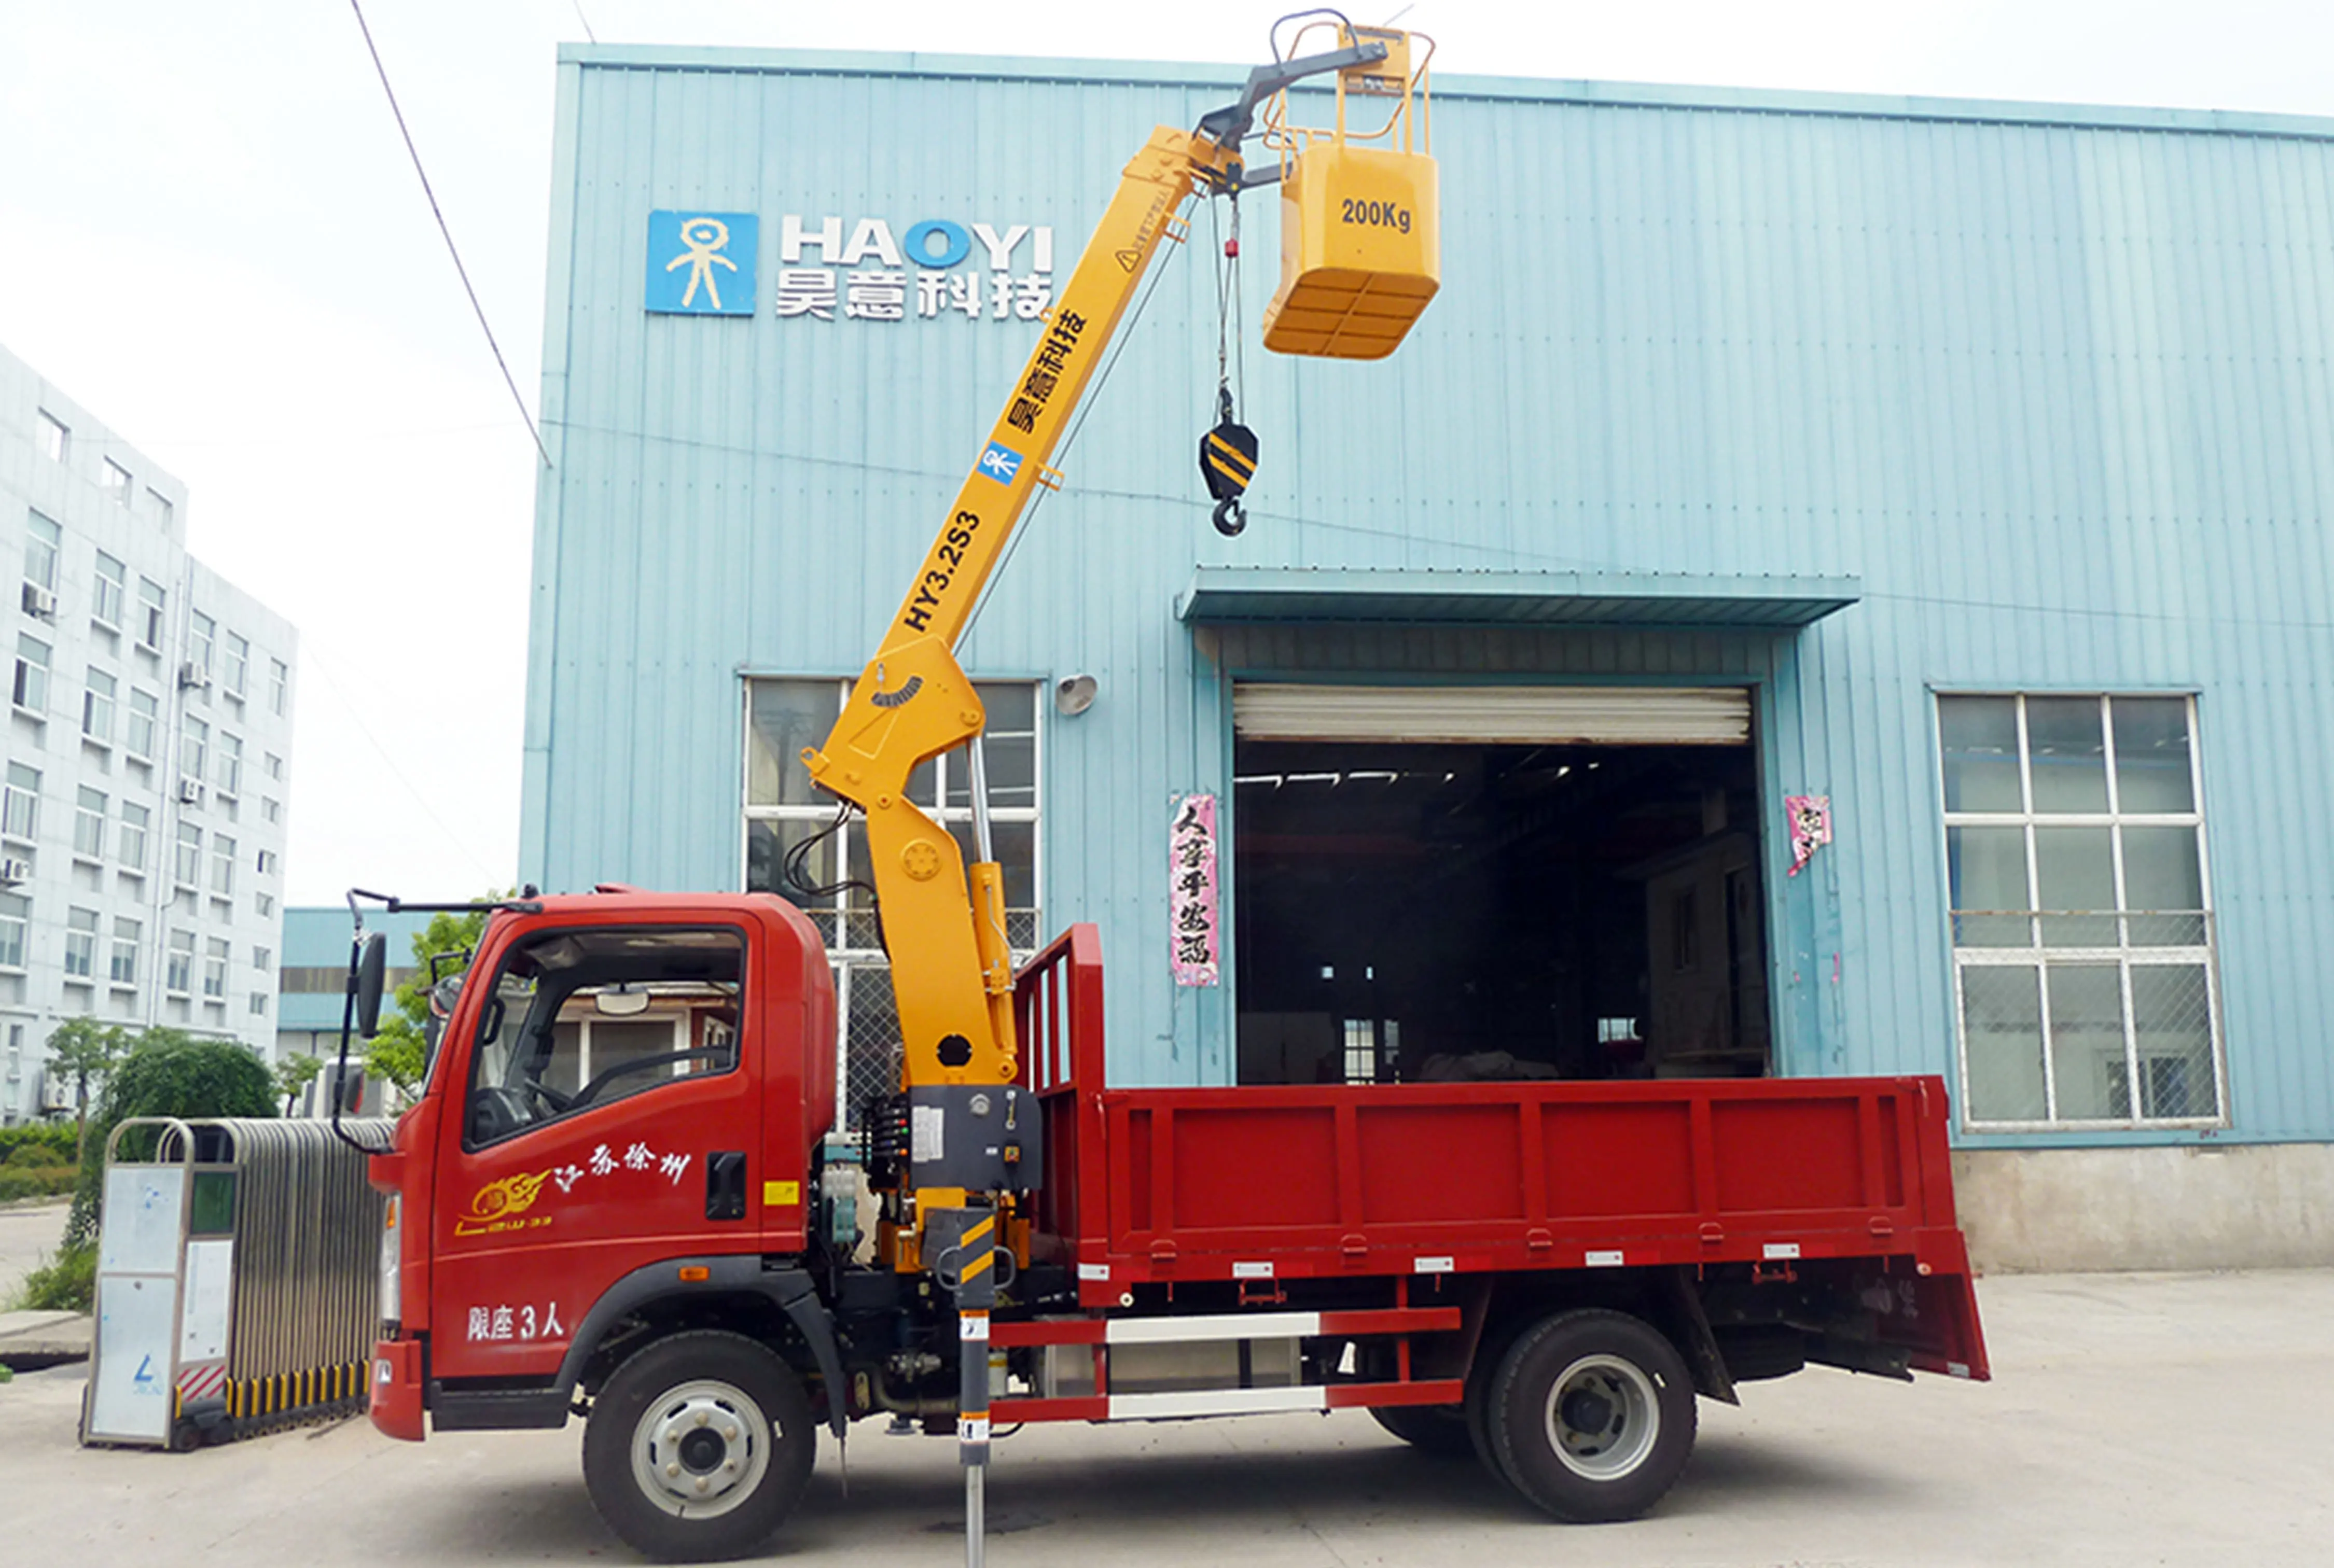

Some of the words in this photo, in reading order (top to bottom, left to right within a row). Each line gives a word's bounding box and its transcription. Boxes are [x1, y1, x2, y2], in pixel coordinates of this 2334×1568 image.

[1342, 198, 1411, 234] 200Kg
[782, 214, 1052, 274] HAOYI
[776, 268, 1052, 323] 昊意科技
[1007, 309, 1088, 435] 昊意科技
[904, 510, 980, 633] HY3.2S3
[554, 1142, 691, 1193] 江苏徐州
[468, 1301, 564, 1341] 限座3人
